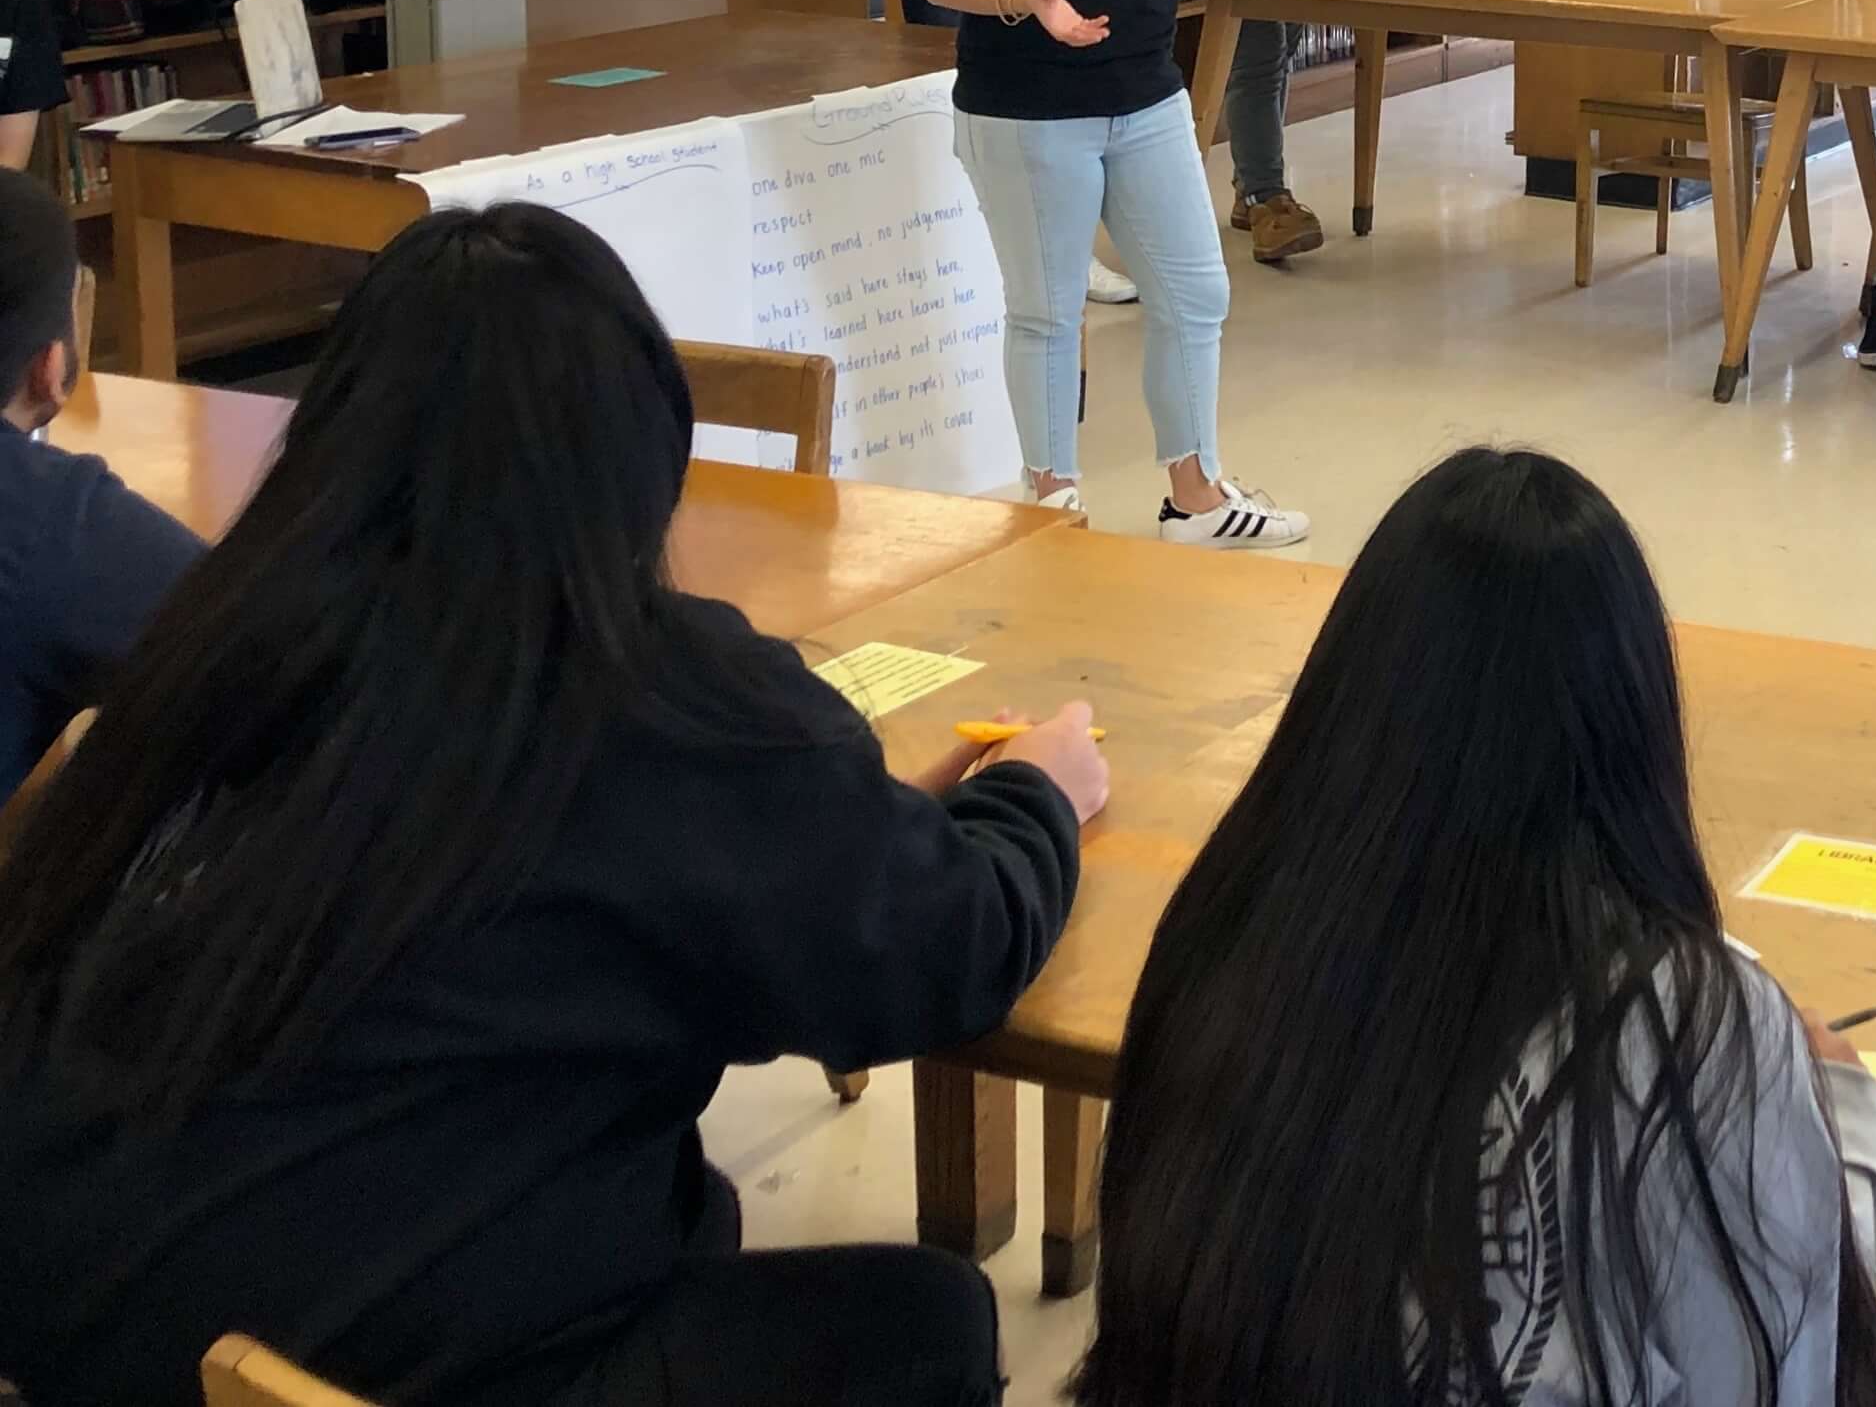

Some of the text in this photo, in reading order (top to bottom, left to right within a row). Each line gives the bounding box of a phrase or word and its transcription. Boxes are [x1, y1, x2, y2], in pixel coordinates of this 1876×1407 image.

[527, 174, 545, 191] As
[752, 149, 886, 197] one diva one mic
[752, 208, 814, 236] respect
[792, 248, 826, 272] open
[877, 225, 893, 242] no
[900, 199, 964, 240] judgement
[825, 287, 853, 310] said
[861, 276, 889, 296] here
[896, 265, 928, 289] stays
[823, 319, 868, 342] learned
[877, 306, 904, 326] here
[910, 296, 945, 315] leaves
[953, 287, 977, 306] here
[910, 341, 930, 357] not
[938, 329, 958, 354] just
[962, 319, 999, 343] respond
[855, 393, 868, 413] in
[872, 386, 901, 406] other
[851, 447, 859, 460] a
[866, 437, 891, 458] book
[899, 429, 915, 449] by
[943, 409, 974, 430] cover
